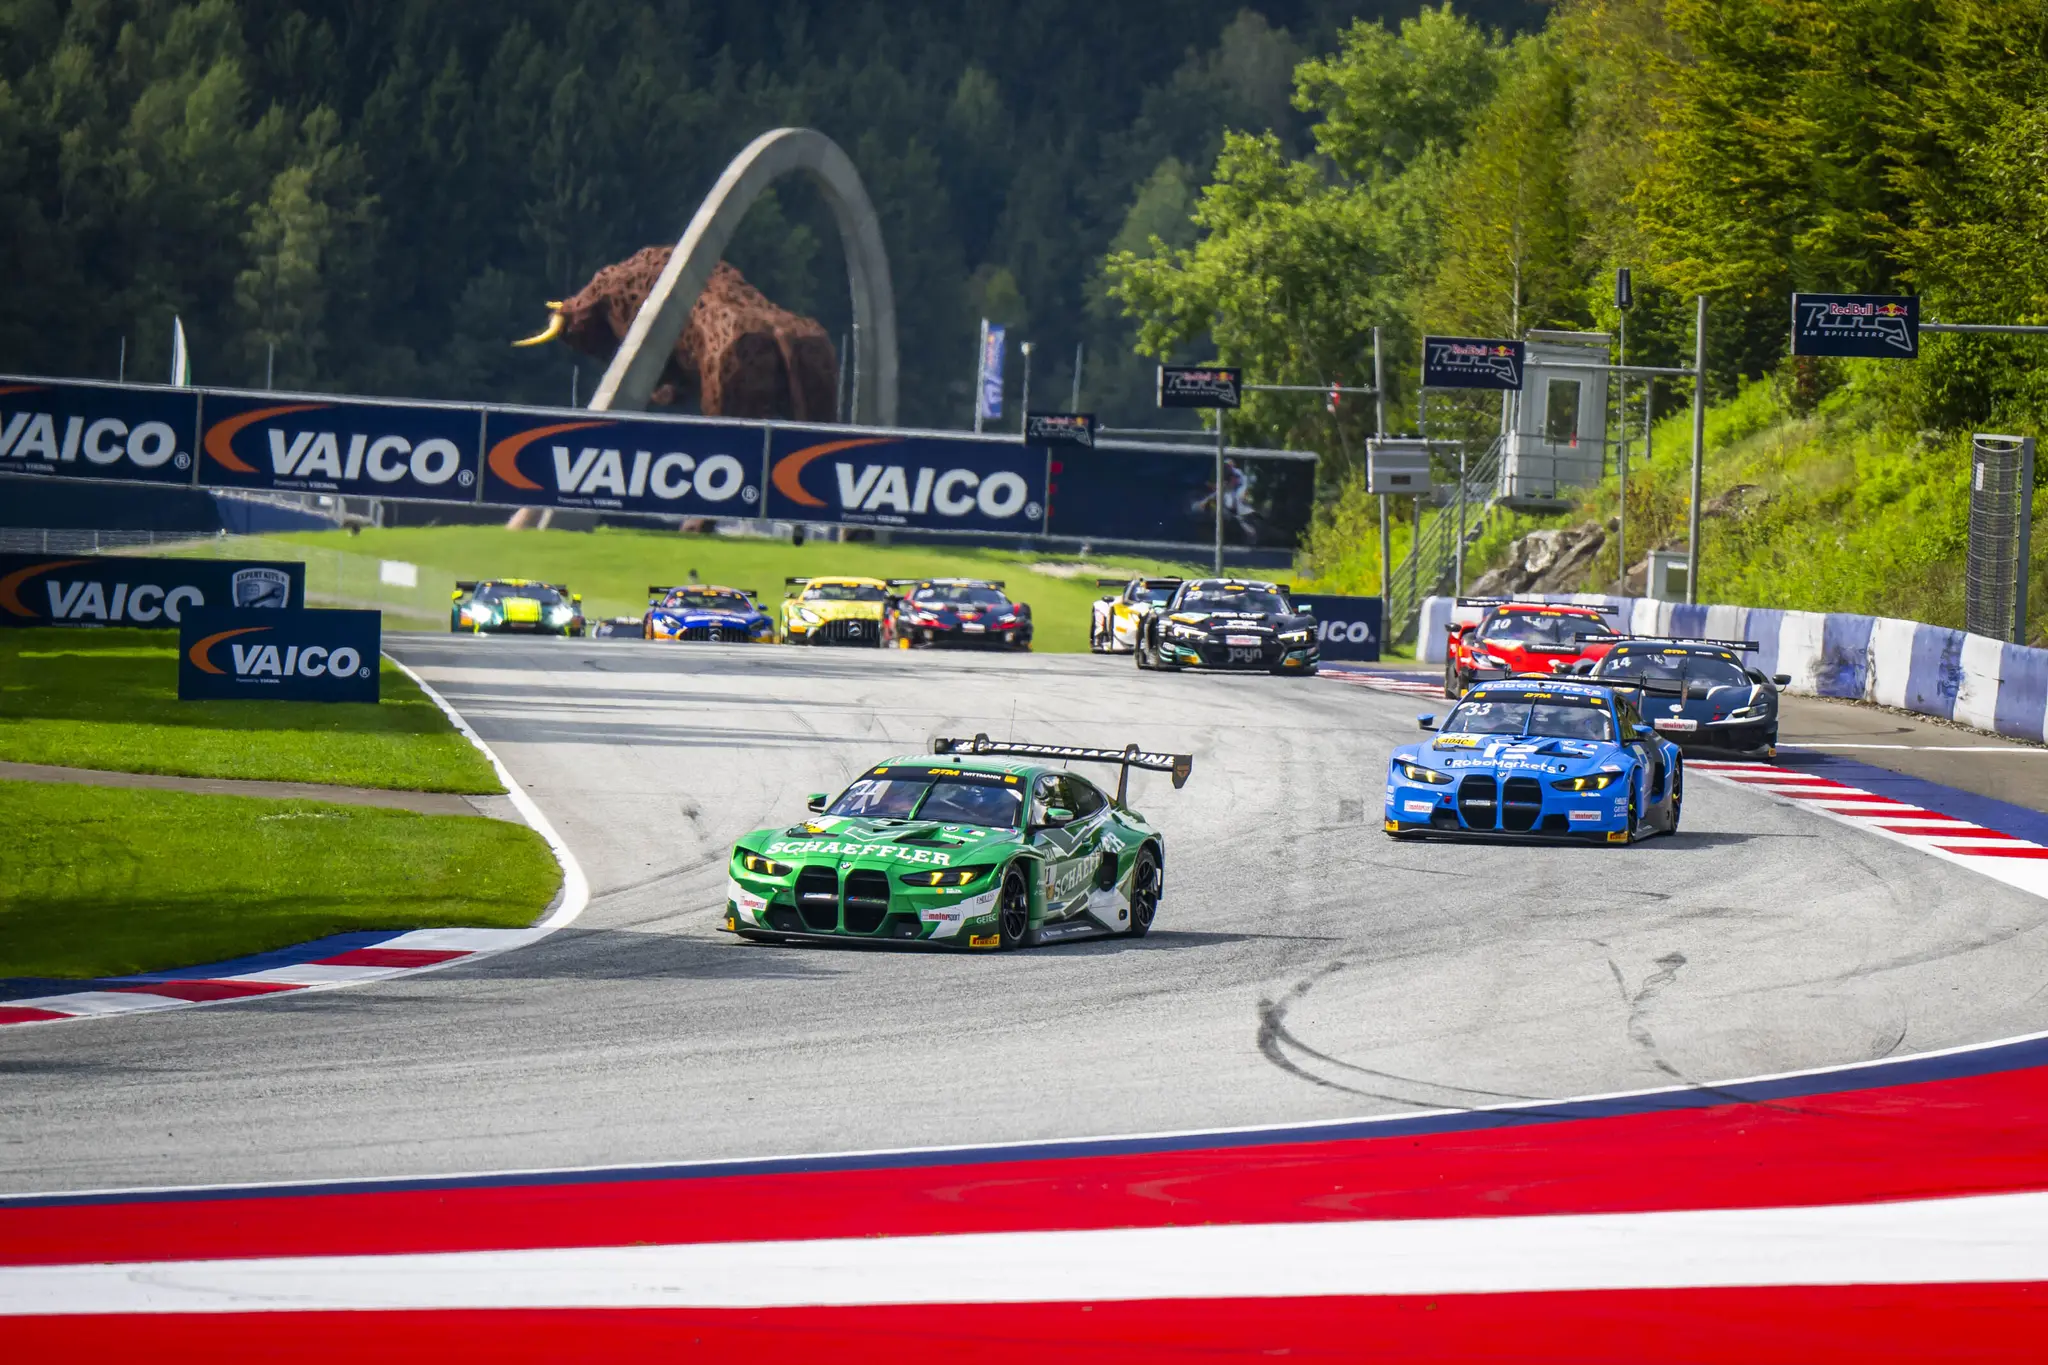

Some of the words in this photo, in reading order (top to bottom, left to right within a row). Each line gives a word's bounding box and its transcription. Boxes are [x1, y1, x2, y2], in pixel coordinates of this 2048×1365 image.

[1829, 302, 1852, 315] Red
[1852, 303, 1874, 316] Bull
[268, 428, 460, 485] VAICO
[552, 446, 744, 501] VAICO
[835, 462, 1028, 518] VAICO
[46, 580, 205, 623] VAICO
[1318, 620, 1369, 643] ICO
[1491, 618, 1511, 630] 10
[231, 644, 360, 677] VAICO
[1611, 656, 1632, 670] 14
[1465, 702, 1493, 716] 33
[928, 768, 960, 777] DTM
[963, 771, 1001, 780] WITTMANN
[1452, 759, 1557, 774] RoboMarkets
[764, 841, 950, 866] SCHAEFFLER
[976, 912, 998, 924] GETEC
